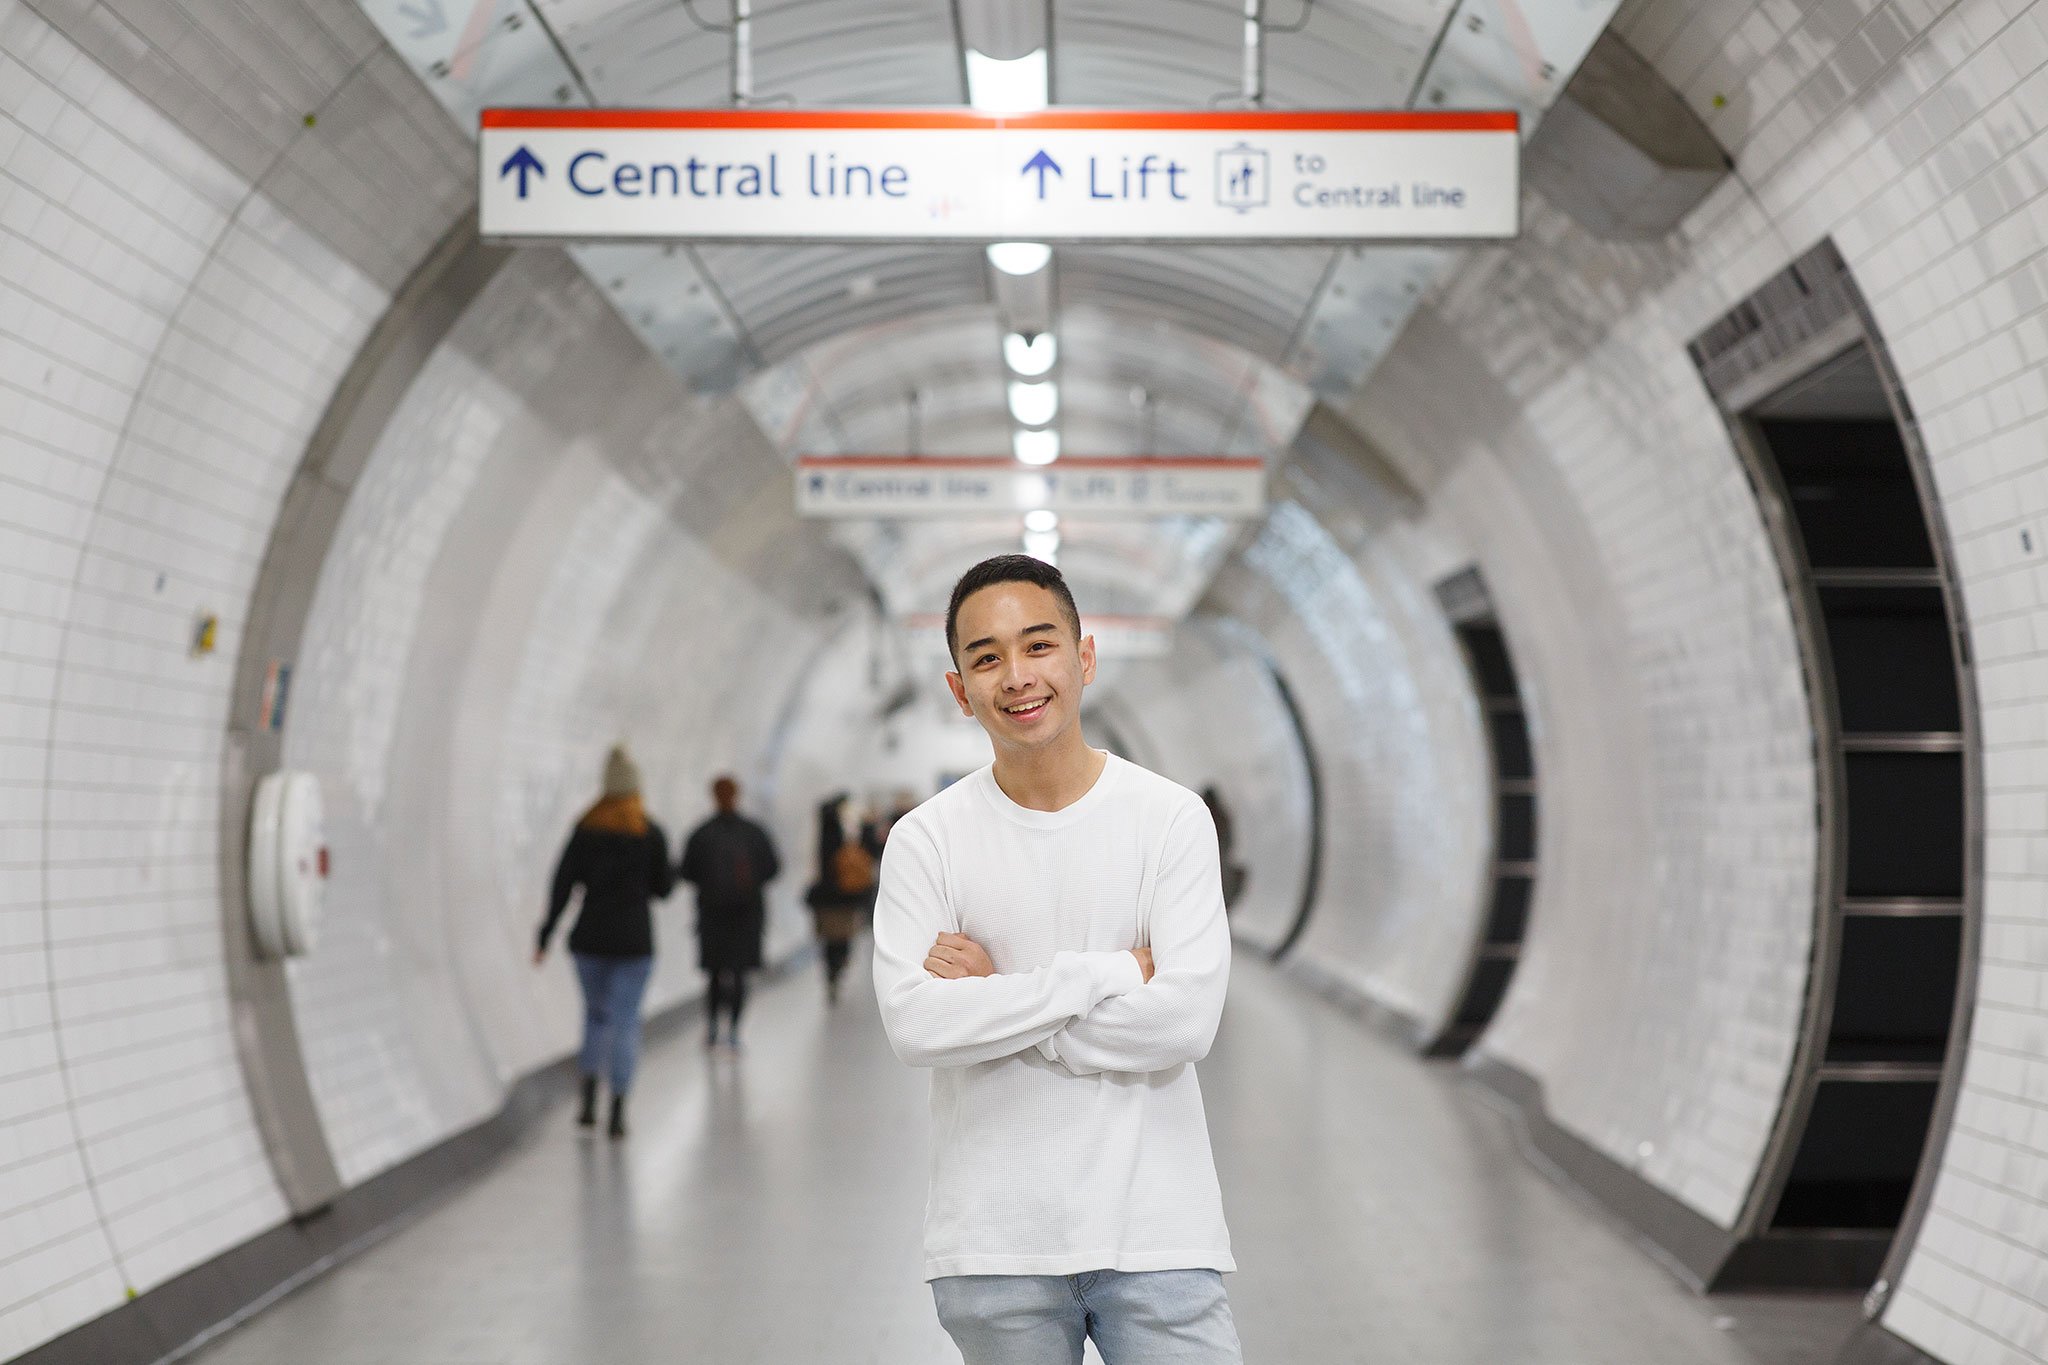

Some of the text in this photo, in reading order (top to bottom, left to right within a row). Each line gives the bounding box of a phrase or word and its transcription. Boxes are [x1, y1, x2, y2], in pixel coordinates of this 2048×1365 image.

[566, 150, 909, 197] Central line
[1088, 154, 1189, 200] Lift
[1294, 153, 1327, 175] to
[1293, 183, 1467, 209] Central line
